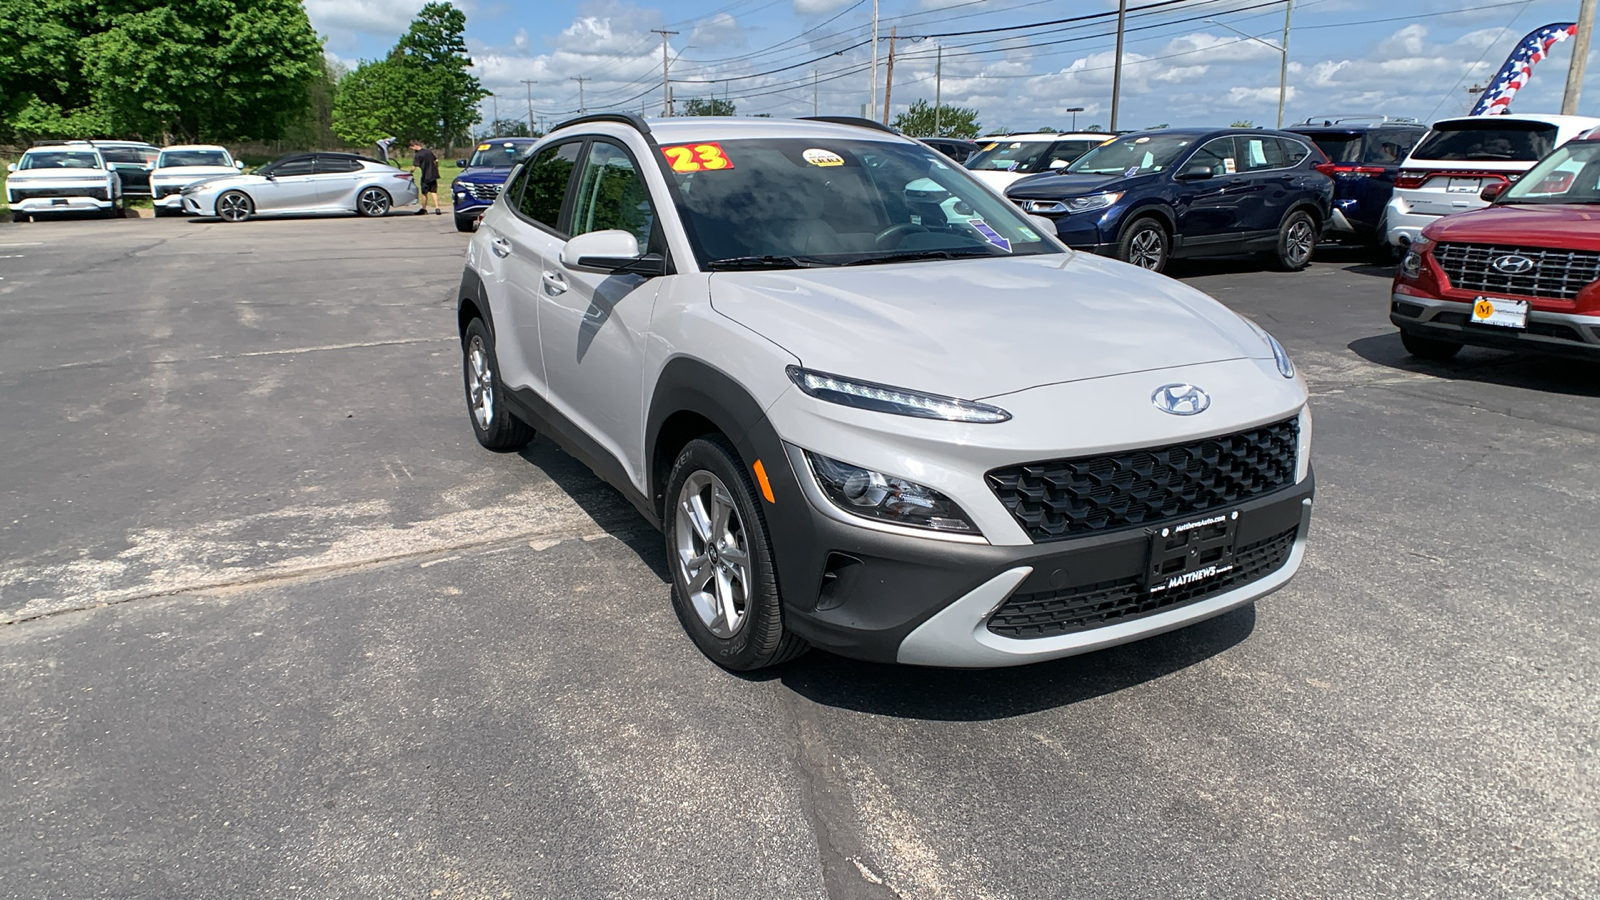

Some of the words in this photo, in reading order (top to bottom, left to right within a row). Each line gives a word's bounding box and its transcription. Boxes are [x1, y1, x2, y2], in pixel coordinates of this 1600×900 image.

[665, 144, 727, 171] 23
[1478, 304, 1490, 315] M
[1175, 515, 1226, 532] MatthewsAuto.com
[1168, 566, 1216, 588] MATTHEWS
